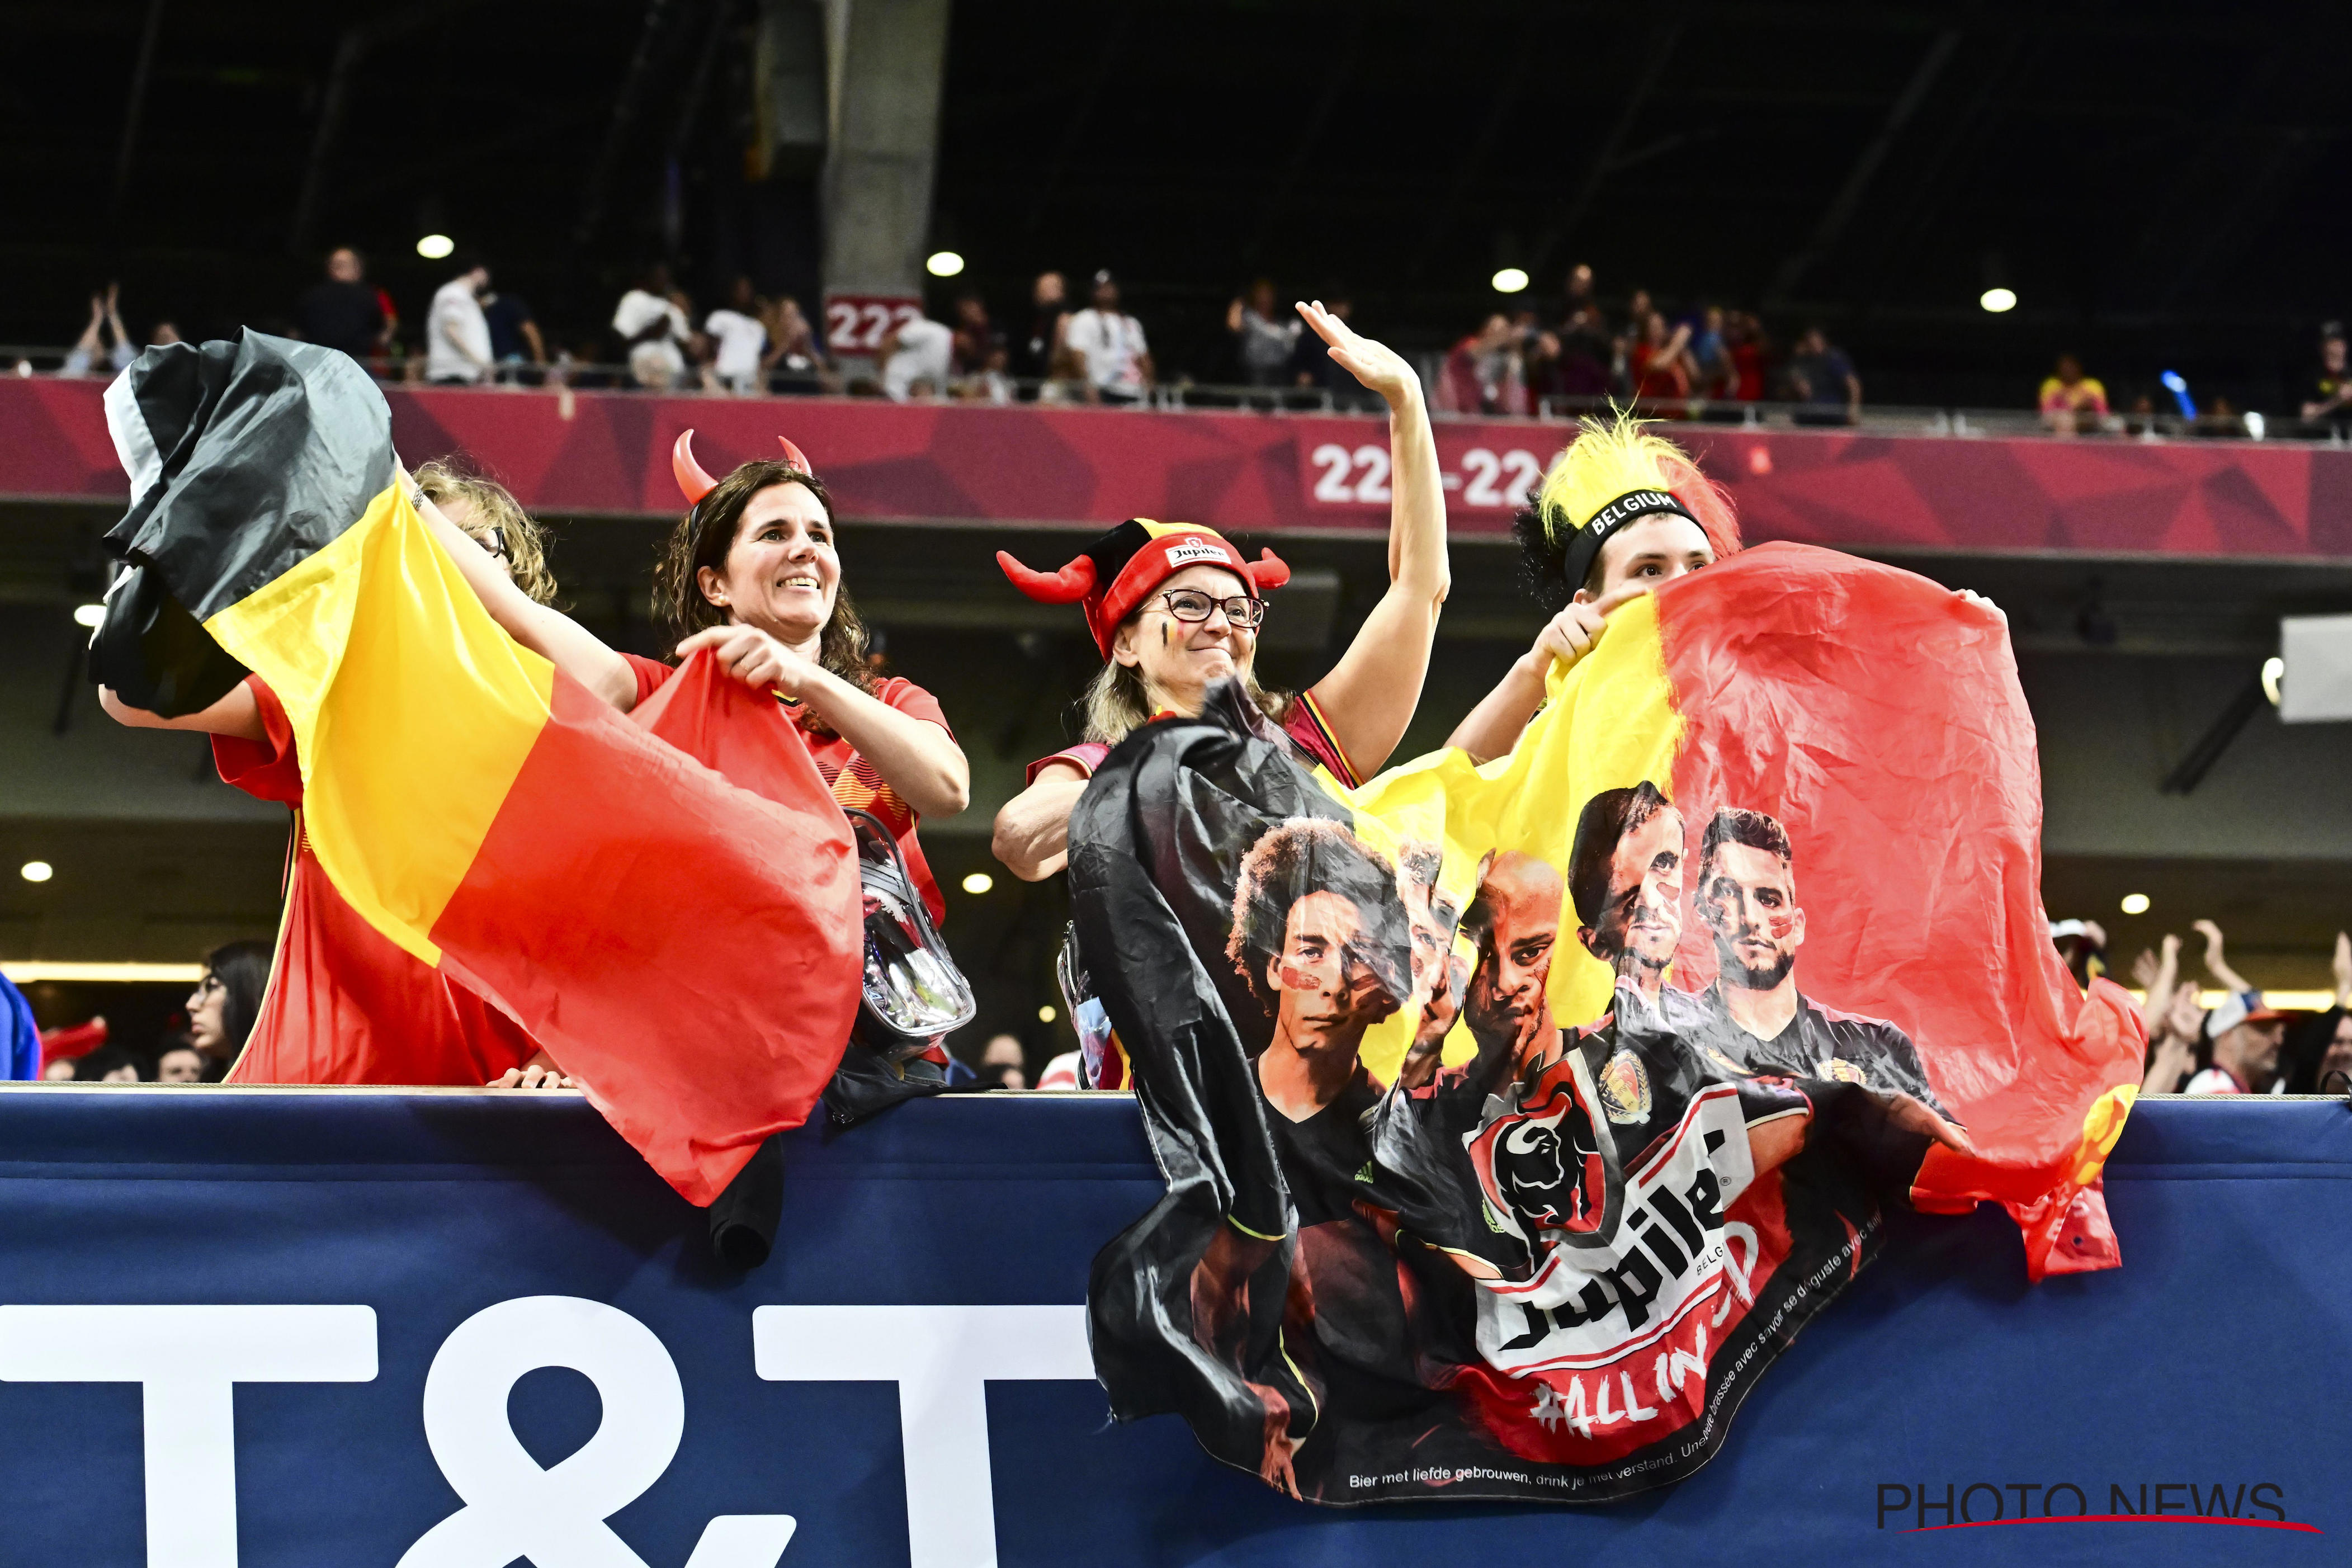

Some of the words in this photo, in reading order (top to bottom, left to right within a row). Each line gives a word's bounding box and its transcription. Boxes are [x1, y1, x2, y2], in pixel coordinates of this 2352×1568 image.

[1312, 444, 1565, 507] 22-22
[1591, 492, 1677, 535] BELGIUM
[1174, 548, 1224, 559] Jupiler
[1498, 1129, 1726, 1351] Jupile
[1696, 1240, 1724, 1276] BELG
[1681, 1437, 1706, 1457] Une
[1709, 1369, 1736, 1416] brassée
[1735, 1342, 1758, 1372] avec
[1758, 1309, 1784, 1344] savoir
[1783, 1295, 1798, 1312] se
[1841, 1229, 1867, 1258] avec
[1349, 1475, 1378, 1488] Bier
[1382, 1470, 1408, 1482] met
[1413, 1466, 1451, 1481] liefde
[1456, 1466, 1531, 1485] gebrouwen,
[1536, 1474, 1569, 1488] drink
[1572, 1478, 1584, 1490] je
[1616, 1453, 1677, 1479] verstand.
